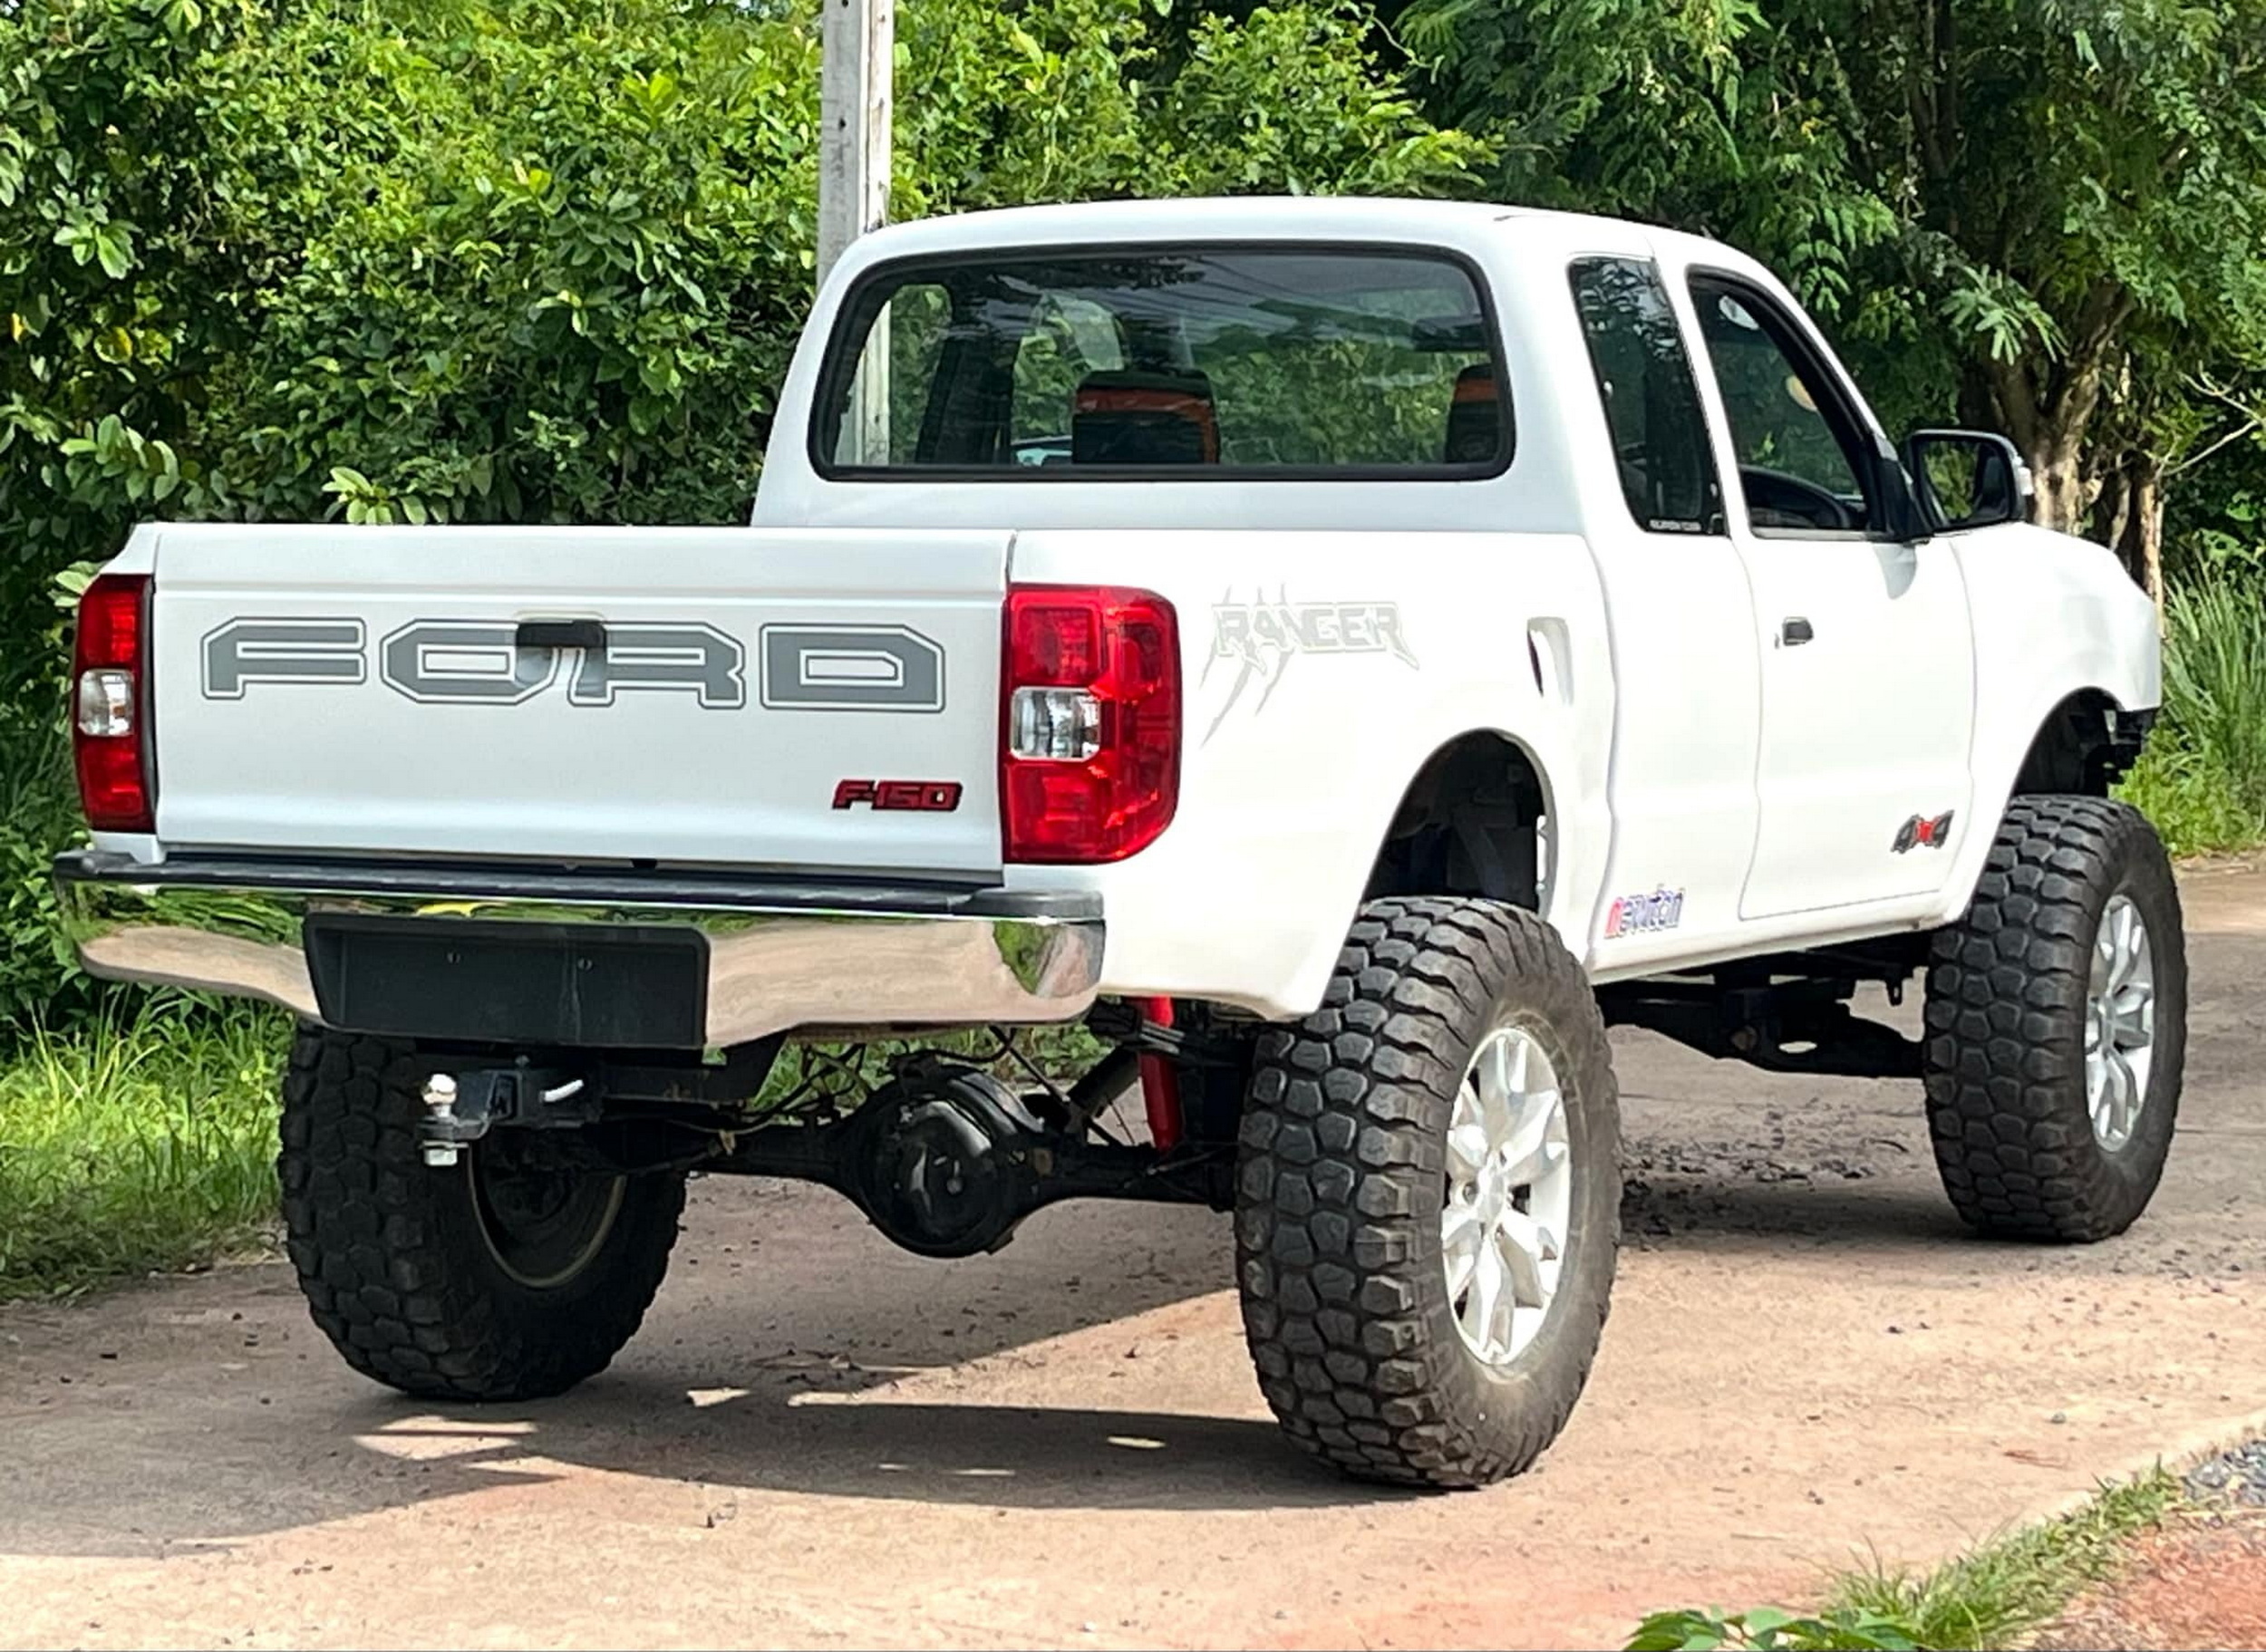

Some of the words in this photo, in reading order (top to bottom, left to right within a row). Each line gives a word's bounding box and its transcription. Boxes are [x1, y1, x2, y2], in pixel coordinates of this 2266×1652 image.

[200, 615, 945, 713] FORD
[1211, 600, 1420, 674] RANGER
[832, 779, 963, 812] F-150
